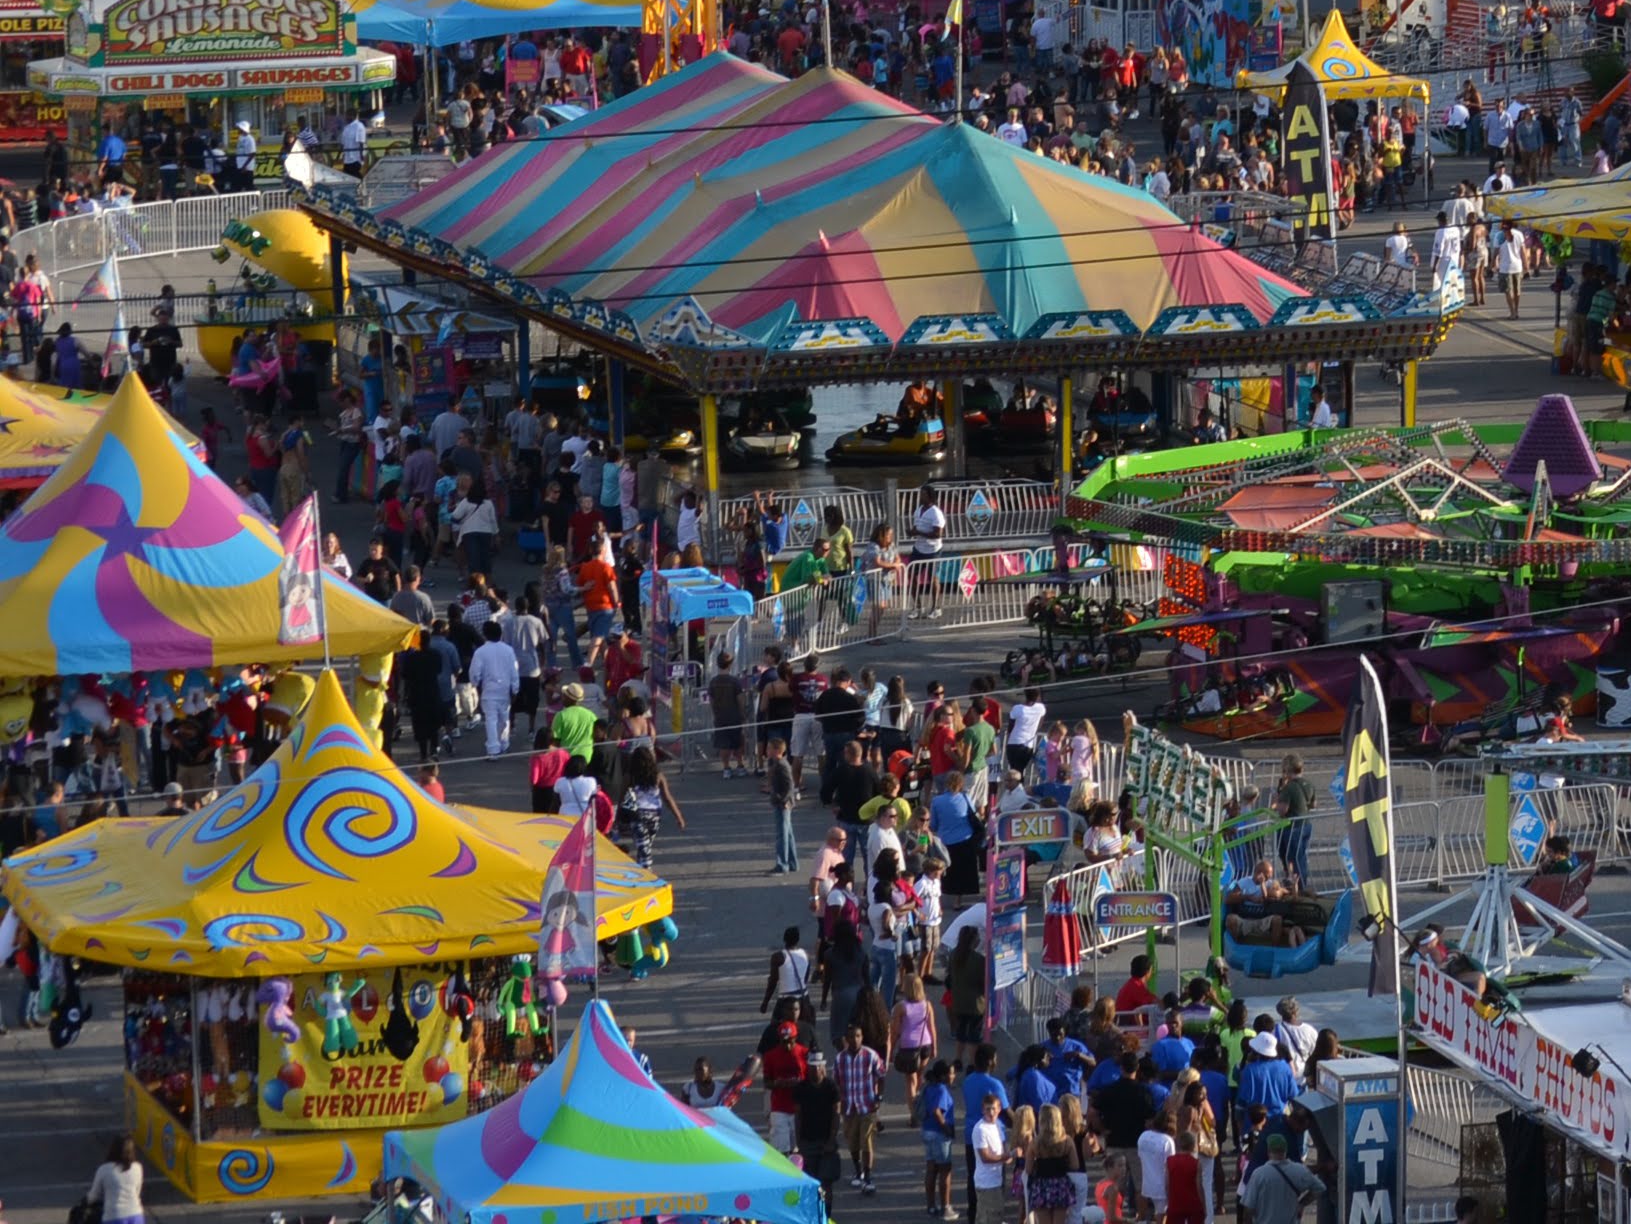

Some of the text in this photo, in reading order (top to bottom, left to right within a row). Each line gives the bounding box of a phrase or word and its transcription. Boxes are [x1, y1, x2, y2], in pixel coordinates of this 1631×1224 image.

[0, 18, 64, 32] OLE PIZ
[126, 4, 320, 51] SAUSAGES
[165, 36, 282, 54] Lemonade
[110, 72, 225, 92] CHILI DOGS
[240, 67, 353, 85] SAUSAGES
[1286, 104, 1330, 230] ATM
[1011, 815, 1056, 838] EXIT
[1101, 901, 1172, 918] ENTRANCE
[1417, 963, 1616, 1143] OLD TIME PHOTOS
[329, 1063, 404, 1092] PRIZE
[1354, 1079, 1389, 1094] ATM
[302, 1091, 428, 1119] EVERYTIME!
[1348, 1107, 1393, 1224] ATM
[581, 1193, 708, 1220] FISH POND
